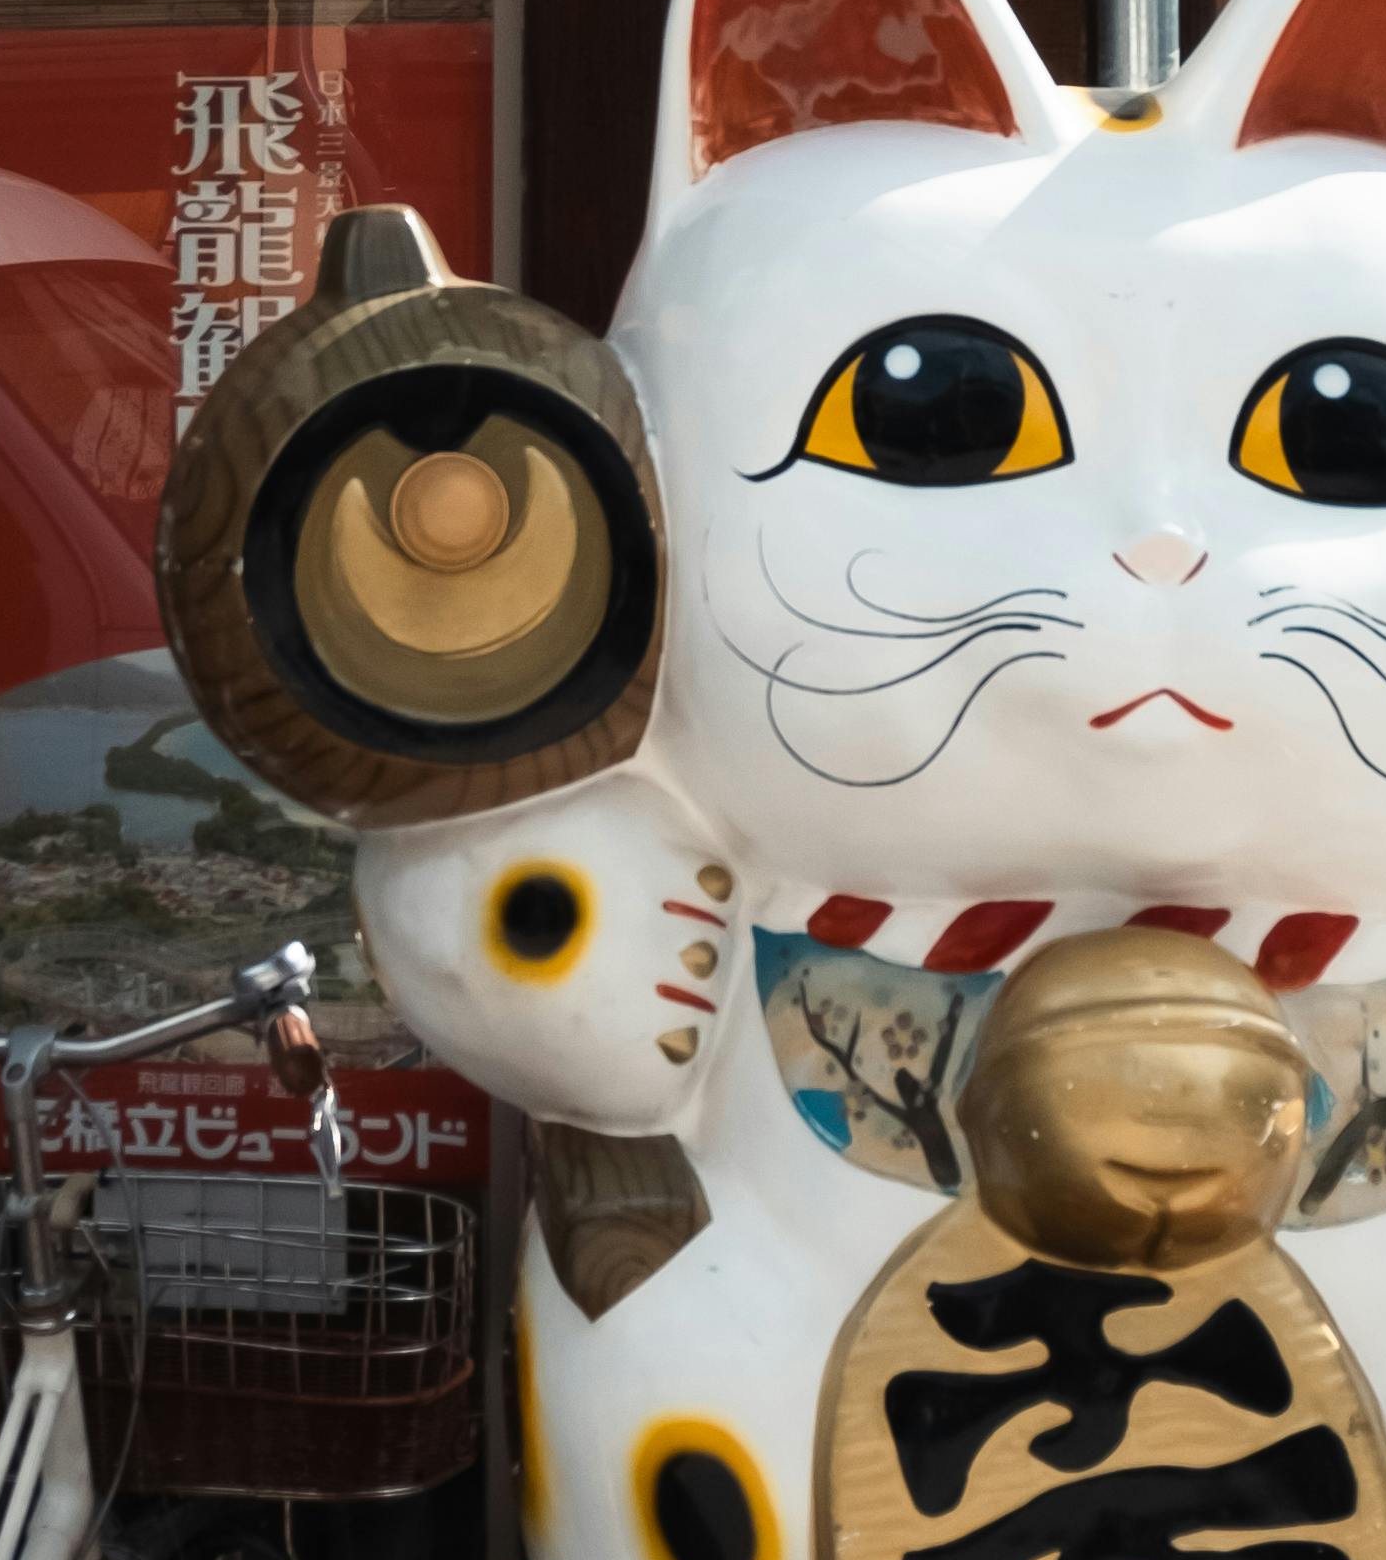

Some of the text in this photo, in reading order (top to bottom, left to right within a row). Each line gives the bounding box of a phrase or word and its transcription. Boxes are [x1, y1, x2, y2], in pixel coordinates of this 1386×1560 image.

[169, 70, 304, 446] 飛龍観
[315, 69, 347, 248] 日本三景天
